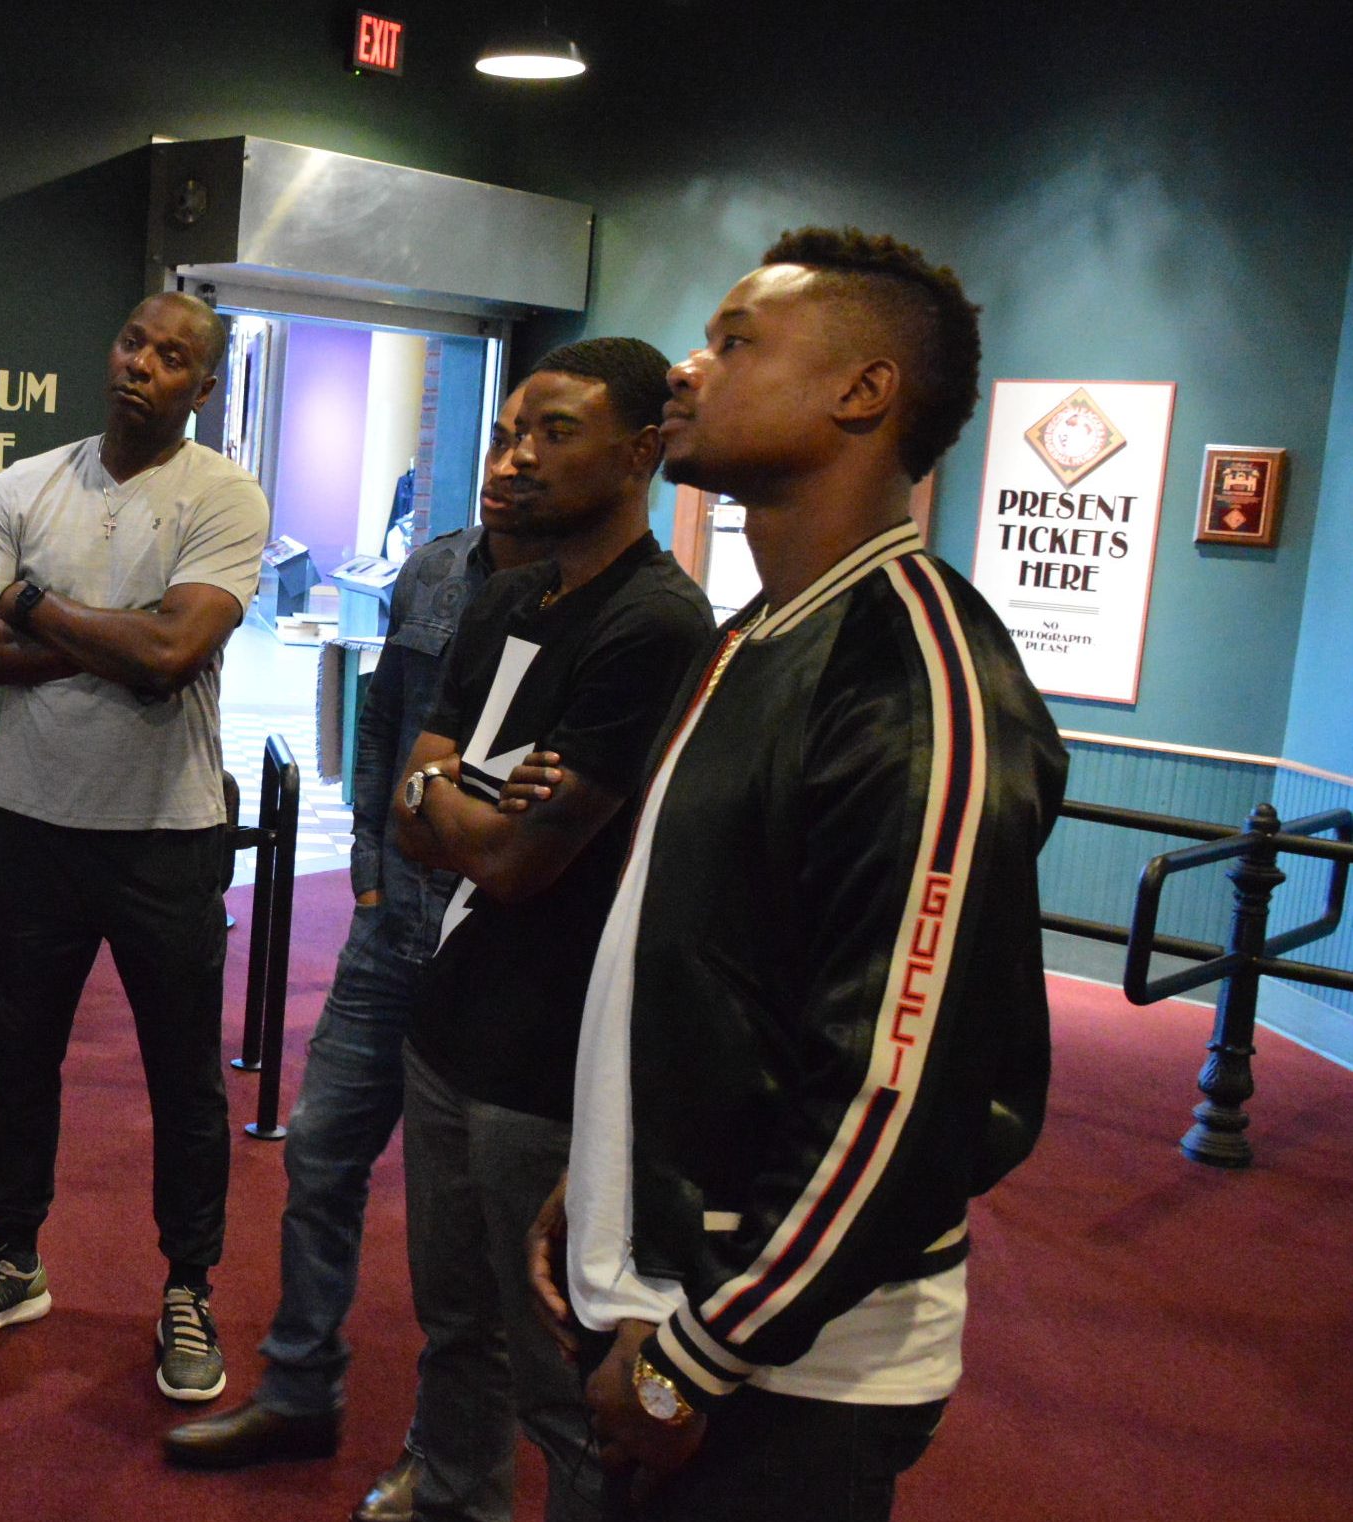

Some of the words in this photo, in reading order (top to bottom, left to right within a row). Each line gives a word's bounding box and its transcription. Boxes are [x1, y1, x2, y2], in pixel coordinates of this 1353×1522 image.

[358, 14, 402, 69] EXIT
[998, 489, 1139, 523] PRESENT
[998, 524, 1129, 559] TICKETS
[1018, 560, 1100, 592] HERE
[1025, 640, 1070, 654] PLEASE
[888, 873, 953, 1087] GUCCI
